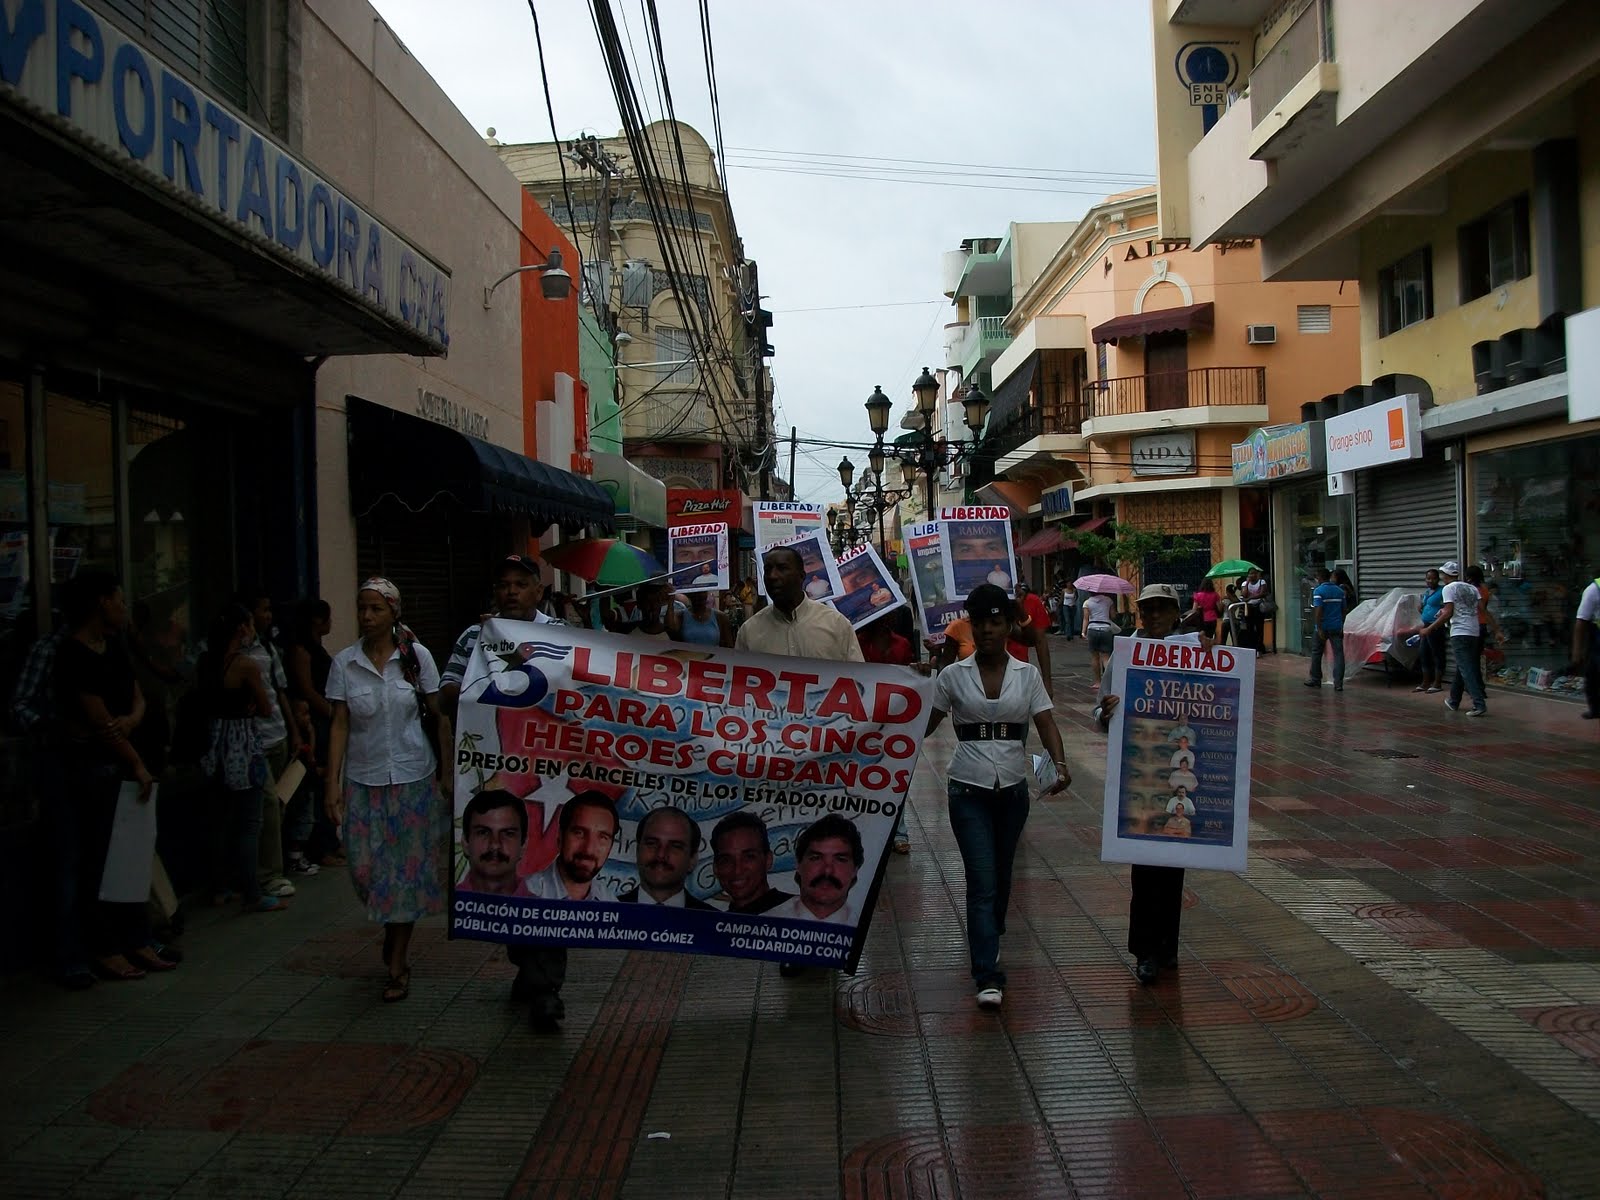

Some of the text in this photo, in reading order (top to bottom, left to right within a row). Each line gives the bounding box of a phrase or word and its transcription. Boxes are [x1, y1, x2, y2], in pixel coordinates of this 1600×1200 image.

[1193, 93, 1224, 104] POR
[1124, 240, 1191, 262] AID
[1329, 428, 1373, 452] Orange shop
[1390, 438, 1404, 448] orange
[1137, 446, 1186, 461] AIDA
[683, 499, 732, 513] Pizza Hut
[941, 507, 1010, 520] LIBERTAD
[670, 523, 726, 538] LIBERTAD!
[960, 525, 997, 537] RAMÓN
[500, 640, 515, 652] the
[1132, 642, 1235, 672] LIBERTAD
[571, 646, 923, 724] LIBERTAD
[1144, 679, 1215, 702] 8 YEARS
[1134, 697, 1232, 720] OF INJUSTICE
[555, 688, 677, 732] PARA
[691, 710, 768, 744] LOS
[781, 723, 916, 760] CINCO
[1200, 727, 1235, 738] GERARDO
[524, 721, 911, 794] HÉROES CUBANOS
[1200, 751, 1233, 761] ANTONIO
[457, 750, 529, 773] PRESOS
[534, 758, 562, 776] EN
[567, 761, 665, 790] CÁRCELES
[671, 777, 698, 796] DE
[703, 783, 738, 800] LOS
[743, 787, 827, 808] ESTADOS
[454, 900, 620, 923] OCIACIÓN DE CUBANOS EN
[453, 916, 695, 945] PÚBLICA DOMINICANA MÁXIMO GÓMEZ
[715, 921, 854, 948] CAMPAÑA DOMINICAN
[730, 937, 813, 956] SOLIDARIDAD
[815, 946, 843, 960] CON
